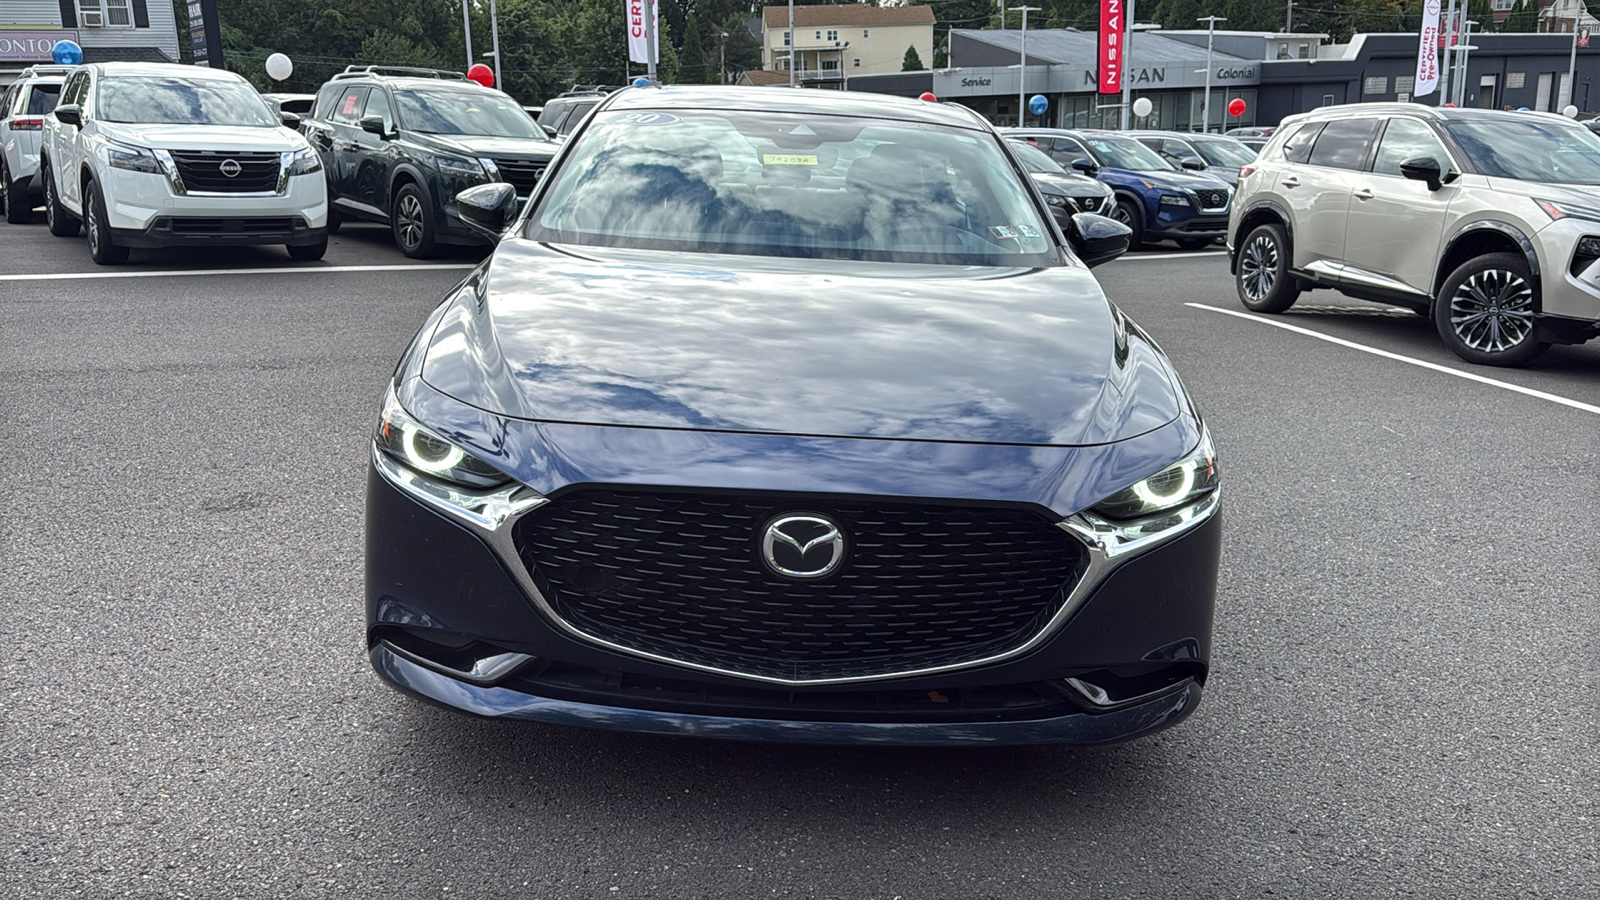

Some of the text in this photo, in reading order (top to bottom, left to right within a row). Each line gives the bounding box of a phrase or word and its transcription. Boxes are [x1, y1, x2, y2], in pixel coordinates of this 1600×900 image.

[0, 39, 56, 53] ONTO
[1107, 0, 1119, 85] NISSAN
[1427, 27, 1437, 81] Pre-Owned
[1217, 67, 1256, 80] Colonial
[961, 77, 992, 87] Service
